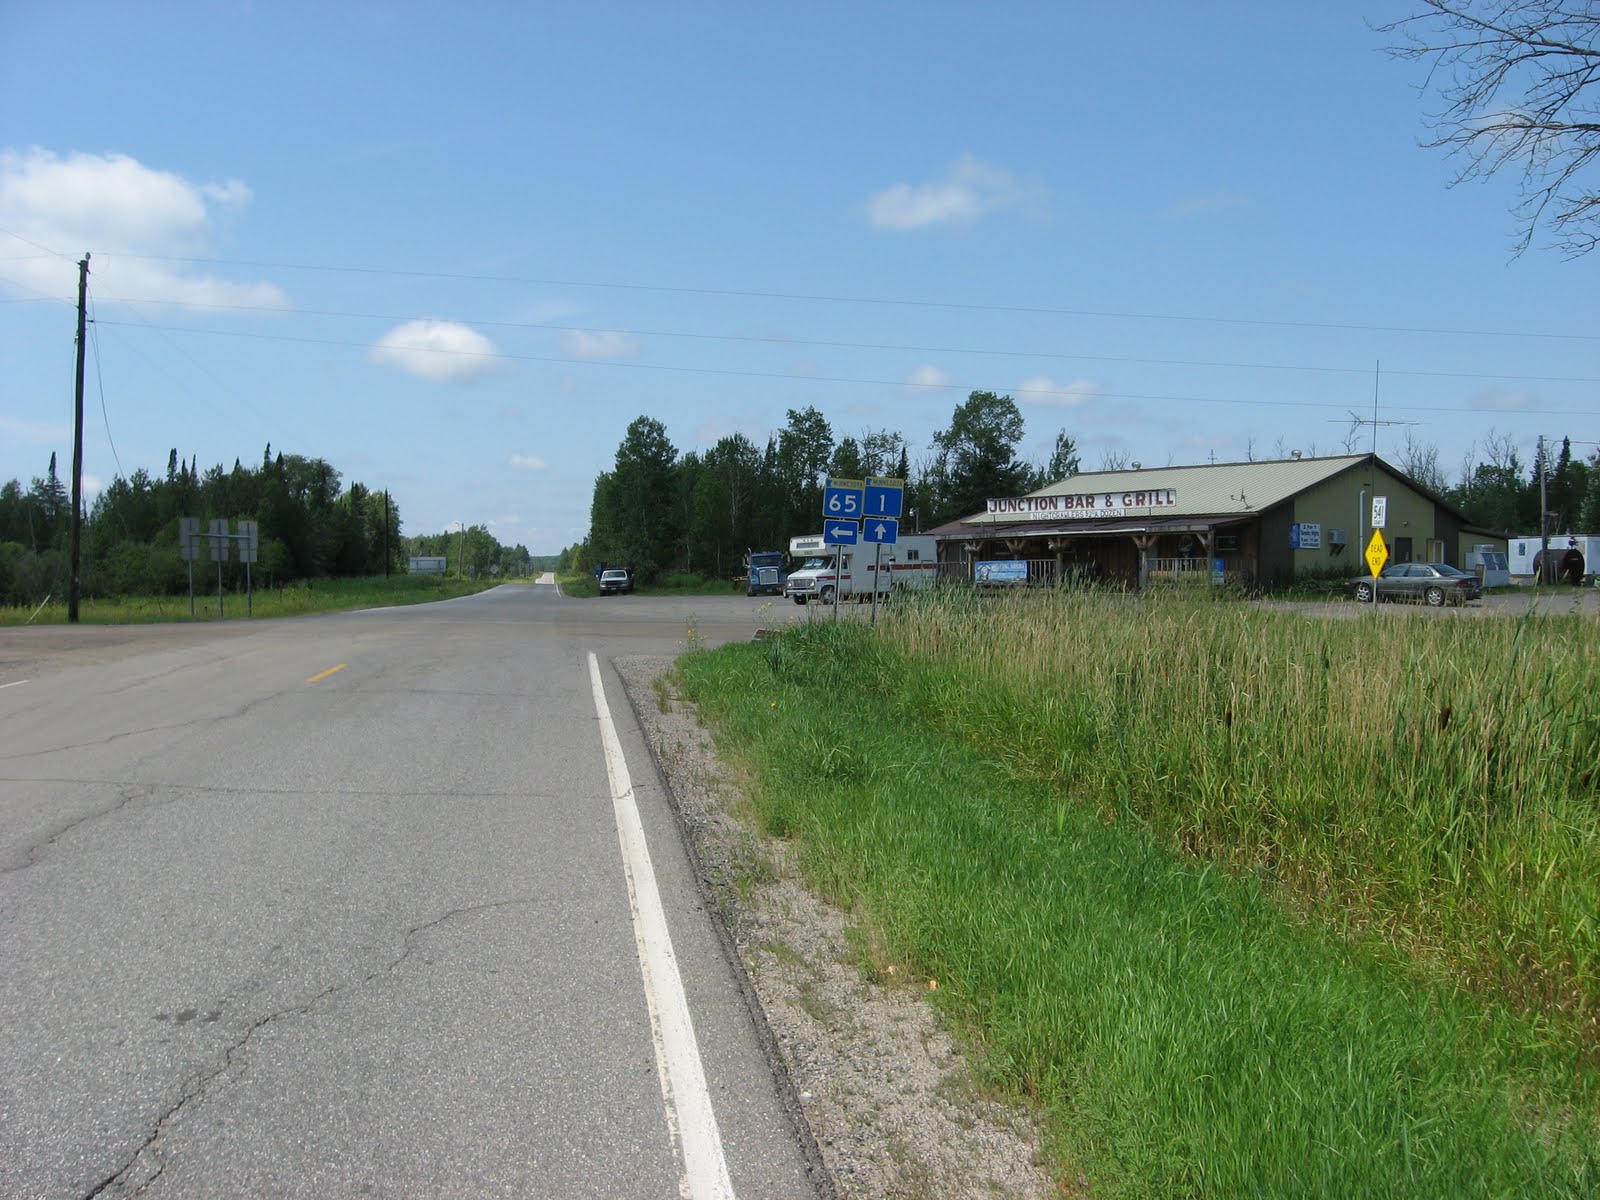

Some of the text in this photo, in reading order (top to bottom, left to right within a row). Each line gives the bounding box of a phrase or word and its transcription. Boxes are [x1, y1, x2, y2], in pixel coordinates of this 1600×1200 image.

[833, 480, 863, 488] MINNESOTA
[872, 479, 903, 487] MINNESOTA
[829, 494, 857, 513] 65
[879, 494, 886, 512] 1
[989, 491, 1174, 513] JUNCTION BAR & GRILL
[1032, 511, 1084, 520] NIGHTCRAWLERS
[1100, 509, 1122, 517] DOZEN
[1373, 505, 1384, 519] 541
[1371, 544, 1383, 553] DEAD
[1372, 557, 1381, 565] END
